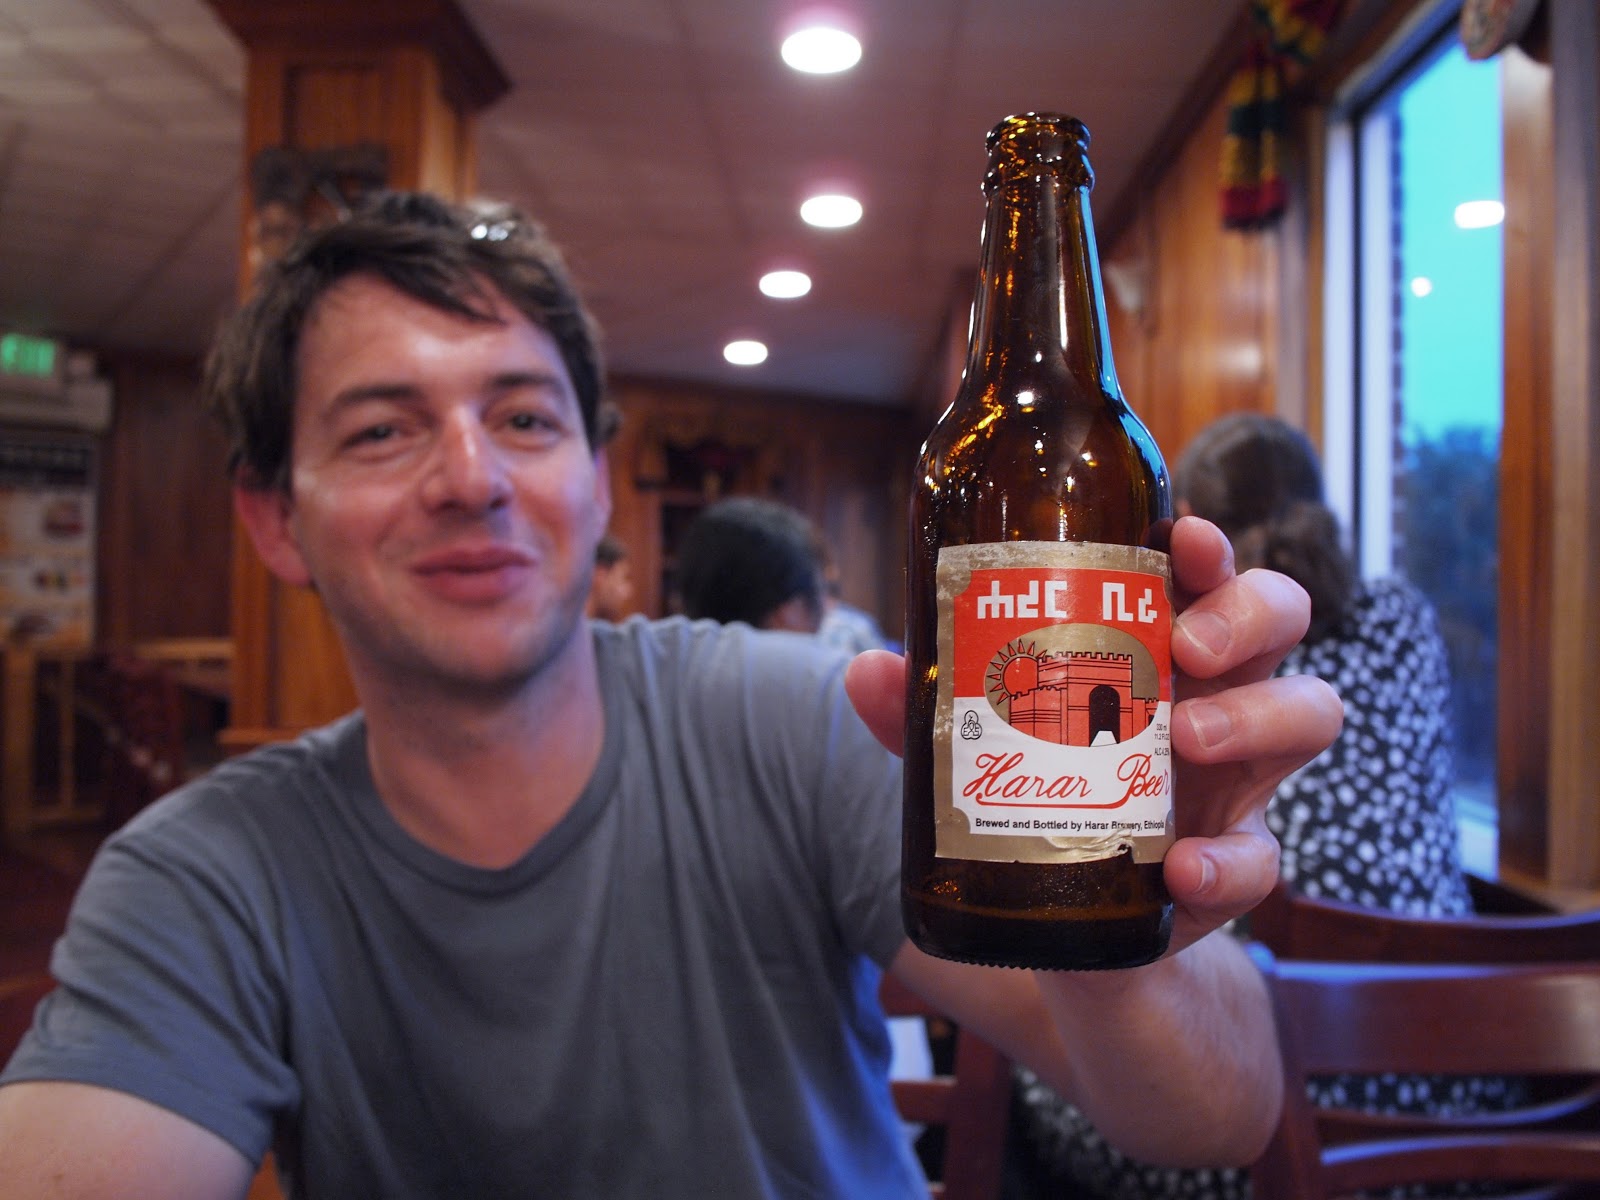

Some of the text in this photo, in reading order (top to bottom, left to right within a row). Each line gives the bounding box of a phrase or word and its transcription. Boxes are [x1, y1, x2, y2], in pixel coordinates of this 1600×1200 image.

[963, 752, 1170, 799] Harar Beer
[975, 818, 1010, 828] Brewed
[1013, 819, 1031, 829] and
[1033, 819, 1068, 830] Bottled
[1071, 820, 1081, 831] by
[1085, 820, 1109, 830] Harar
